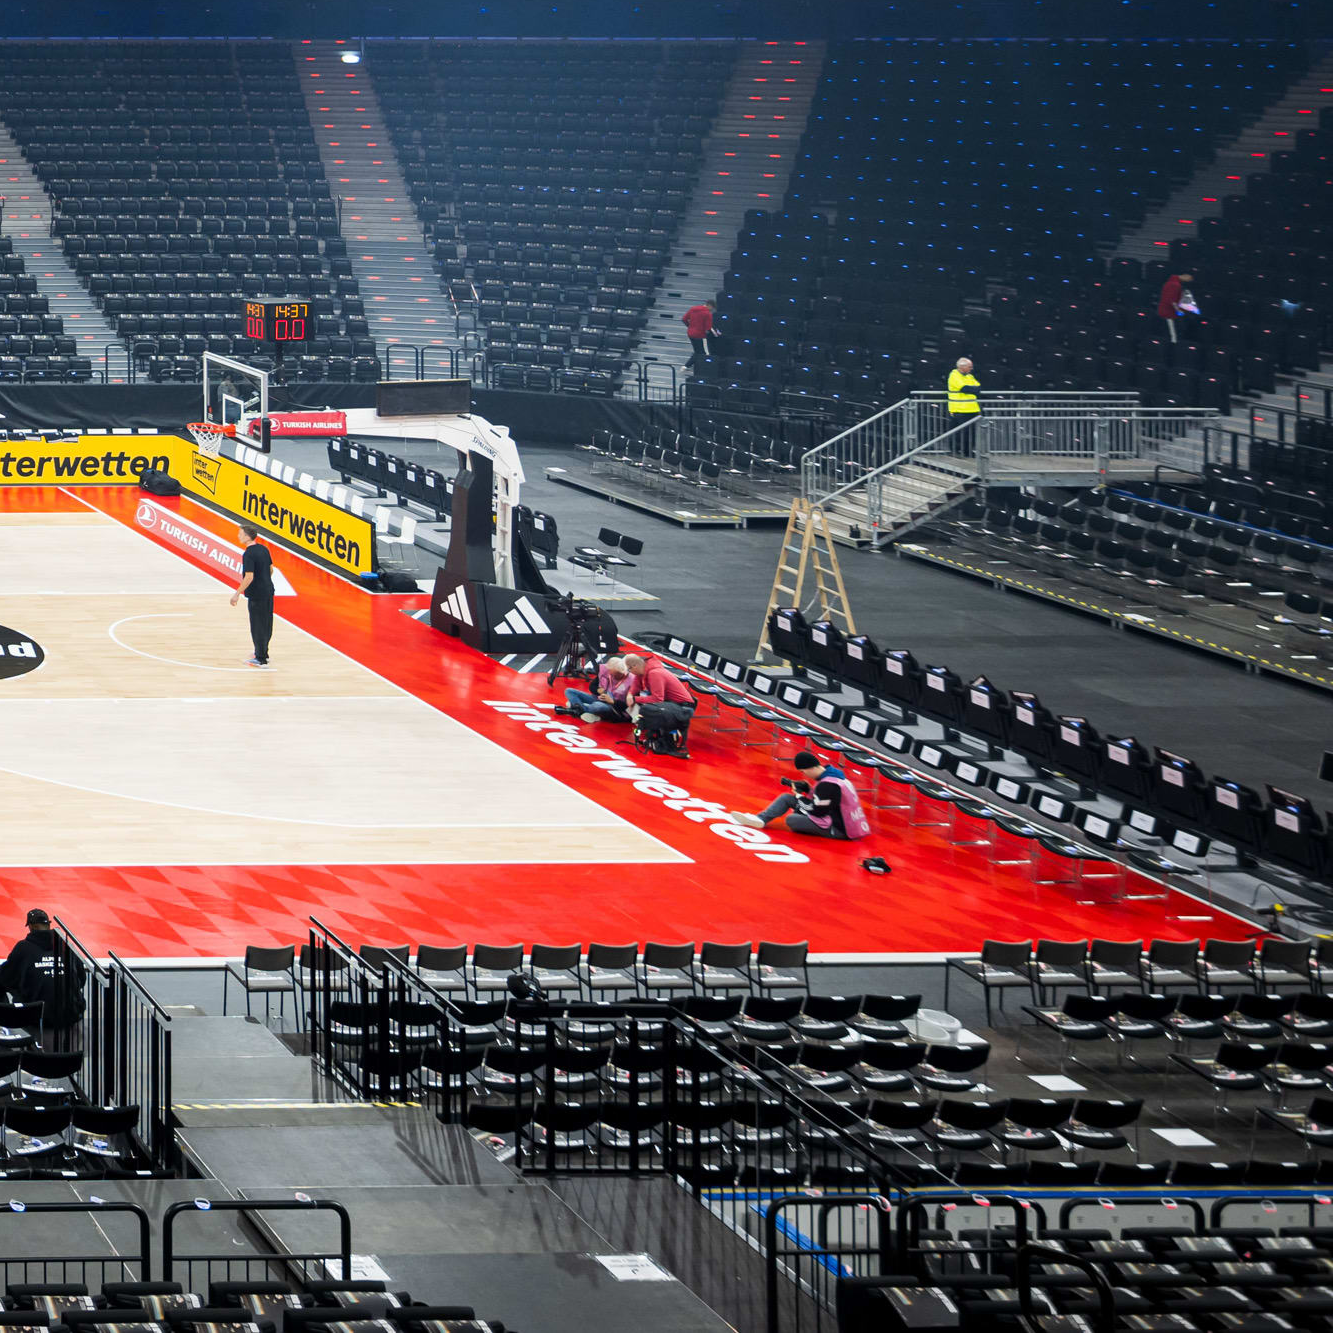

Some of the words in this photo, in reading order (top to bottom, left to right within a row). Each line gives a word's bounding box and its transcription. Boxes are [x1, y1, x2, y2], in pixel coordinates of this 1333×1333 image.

[275, 304, 308, 318] 14:37
[276, 319, 305, 340] 0.0
[472, 435, 498, 458] SPALDING
[193, 455, 208, 472] inter
[194, 465, 214, 483] wetten
[242, 475, 361, 567] interwetten
[160, 519, 209, 554] TURKISH
[483, 700, 811, 863] interwetten
